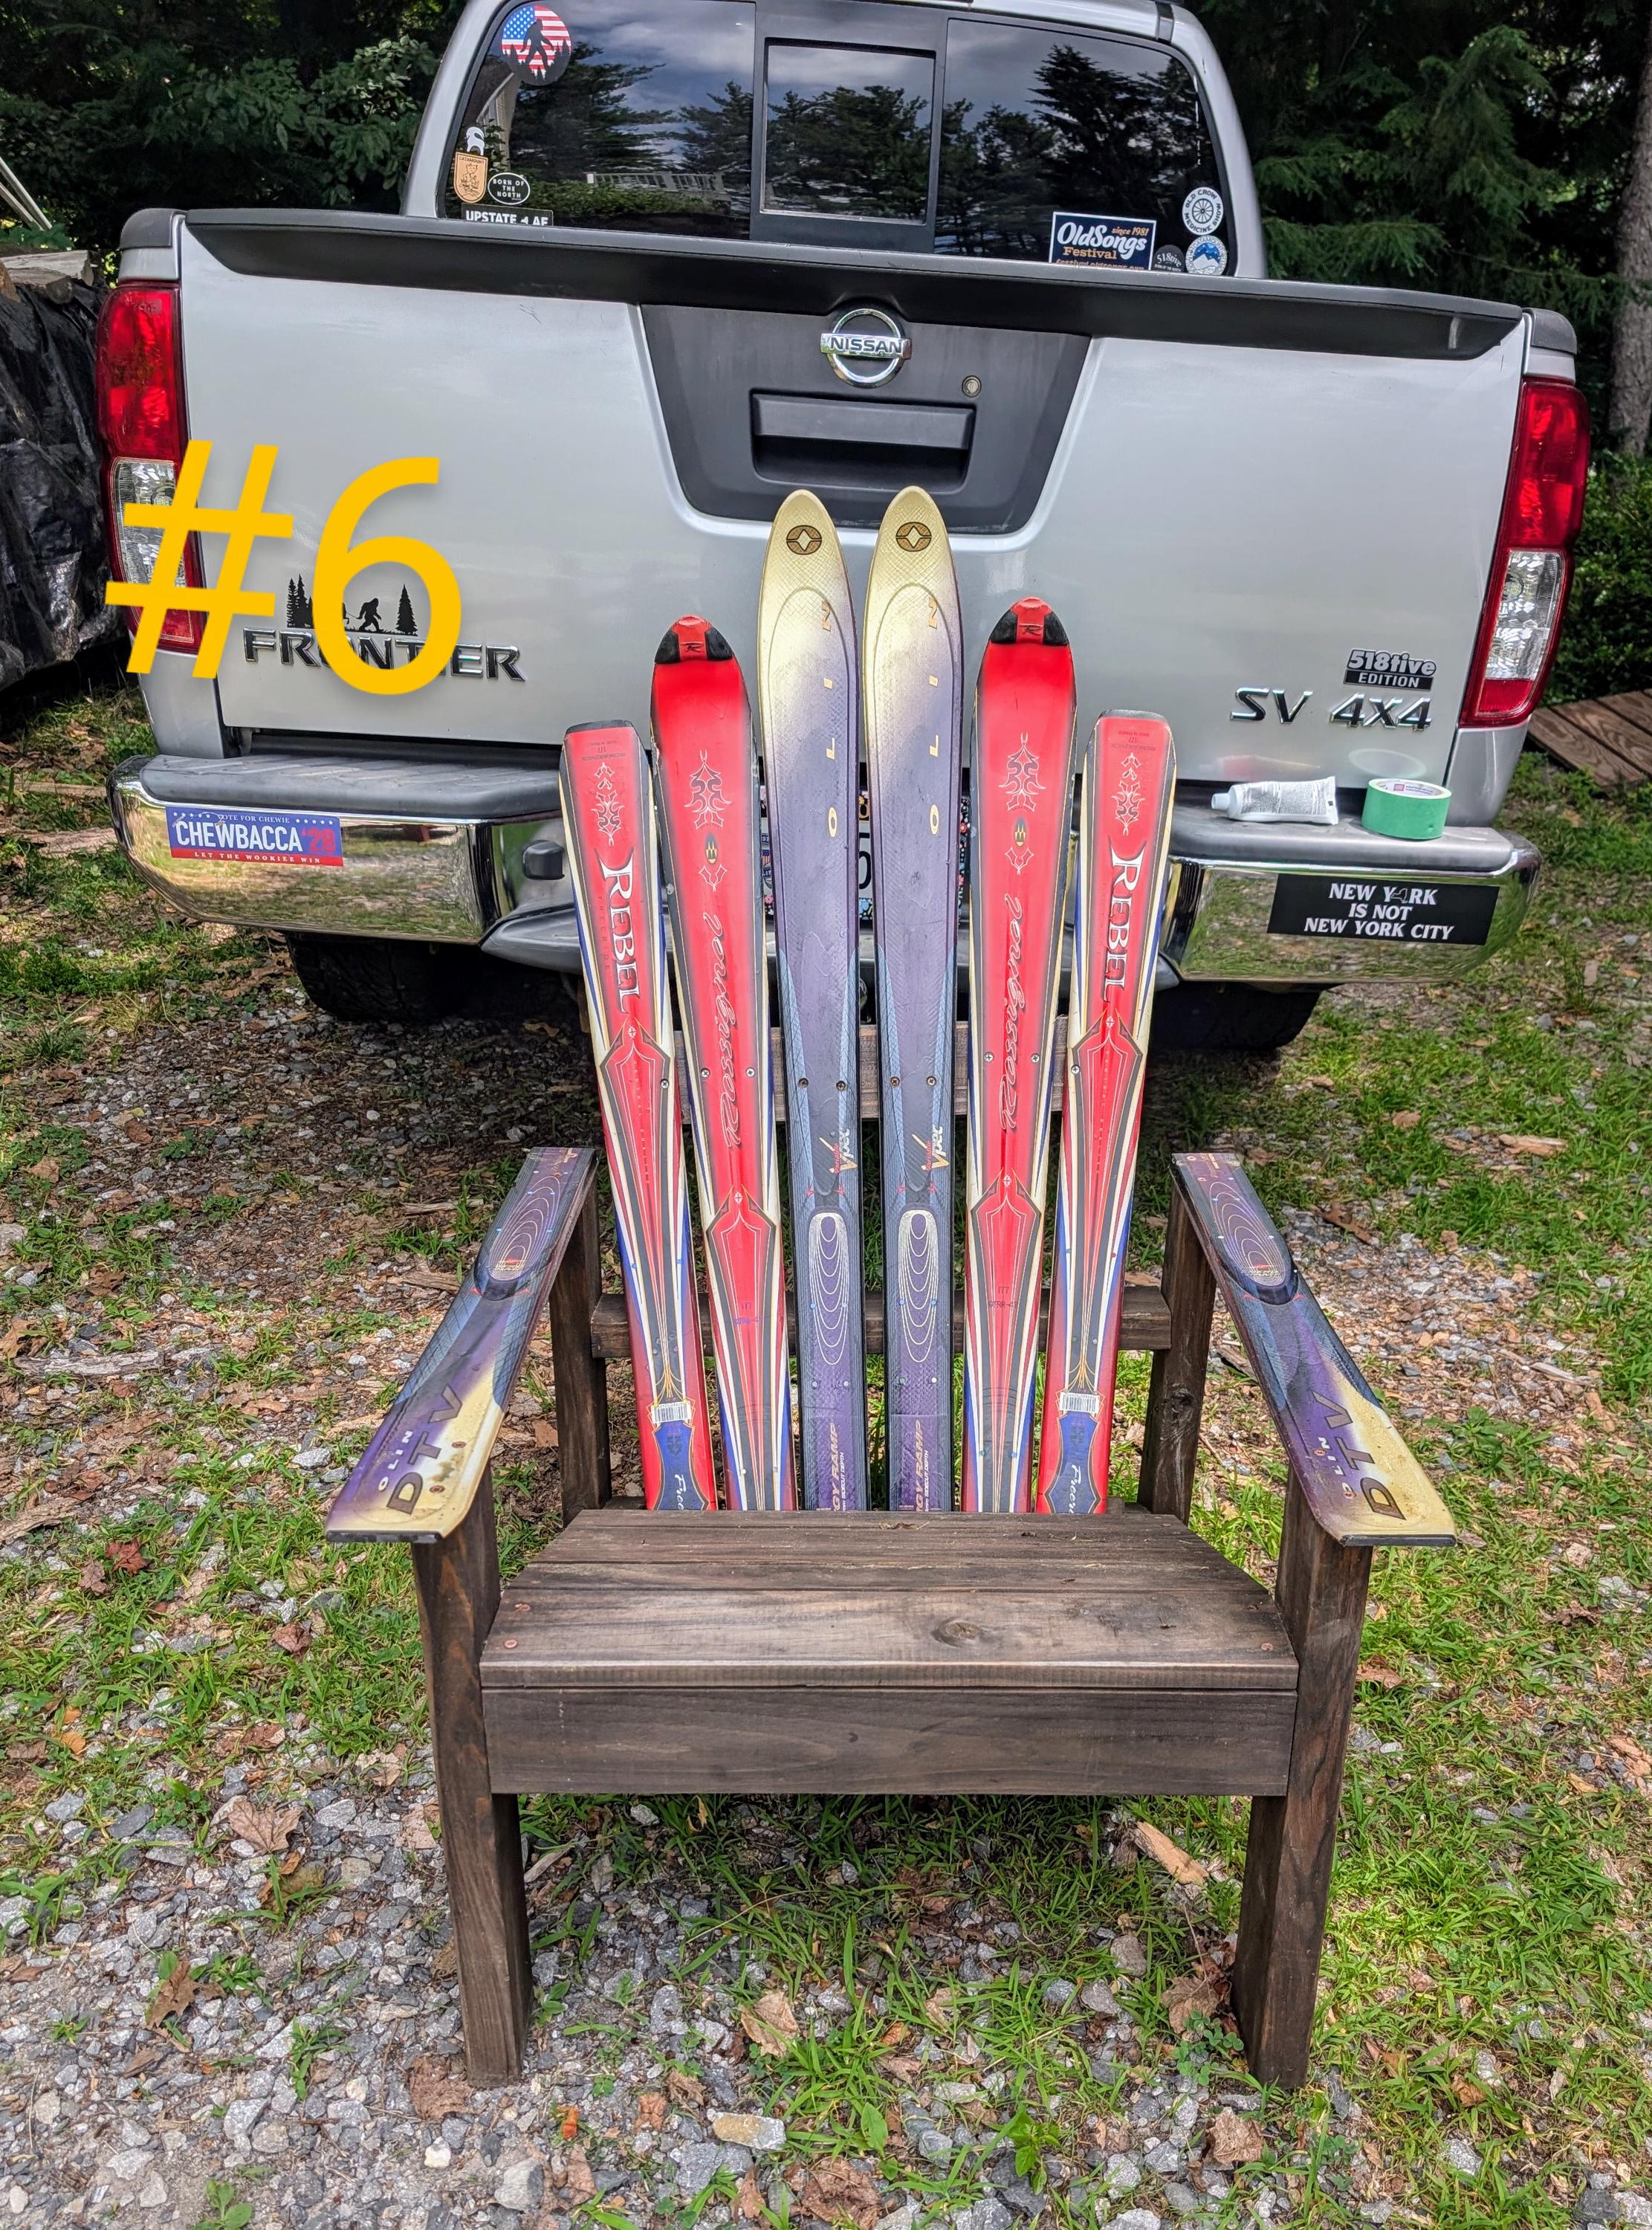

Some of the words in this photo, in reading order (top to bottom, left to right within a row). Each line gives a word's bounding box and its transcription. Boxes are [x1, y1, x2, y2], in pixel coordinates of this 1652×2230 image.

[1185, 193, 1196, 208] OLD
[1197, 189, 1218, 199] CROW
[466, 210, 517, 224] UPSTATE
[532, 216, 548, 226] AF
[1184, 213, 1213, 233] MEDICINE
[1212, 203, 1222, 226] SHOW
[1057, 222, 1147, 259] OldSongs
[1111, 226, 1131, 236] since
[1131, 227, 1150, 236] 1981
[1063, 246, 1117, 259] Festival
[829, 337, 902, 354] NISSAN
[243, 627, 526, 682] FRNTER
[1358, 672, 1419, 688] EDITION
[1230, 687, 1314, 724] SV
[176, 821, 303, 852] CHEWBACCA
[246, 854, 295, 862] WOOKIEE
[1329, 883, 1376, 902] NEW
[1383, 886, 1438, 905] YRK
[1348, 903, 1367, 918] IS
[1372, 905, 1413, 921] NOT
[1304, 917, 1350, 934] NEW
[1354, 920, 1406, 937] YORK
[1410, 924, 1454, 940] CITY
[387, 1385, 462, 1514] DTV
[830, 1422, 839, 1480] RAMP
[915, 1420, 924, 1478] RAMP
[1312, 1391, 1406, 1520] DTV
[378, 1429, 413, 1492] OLIN
